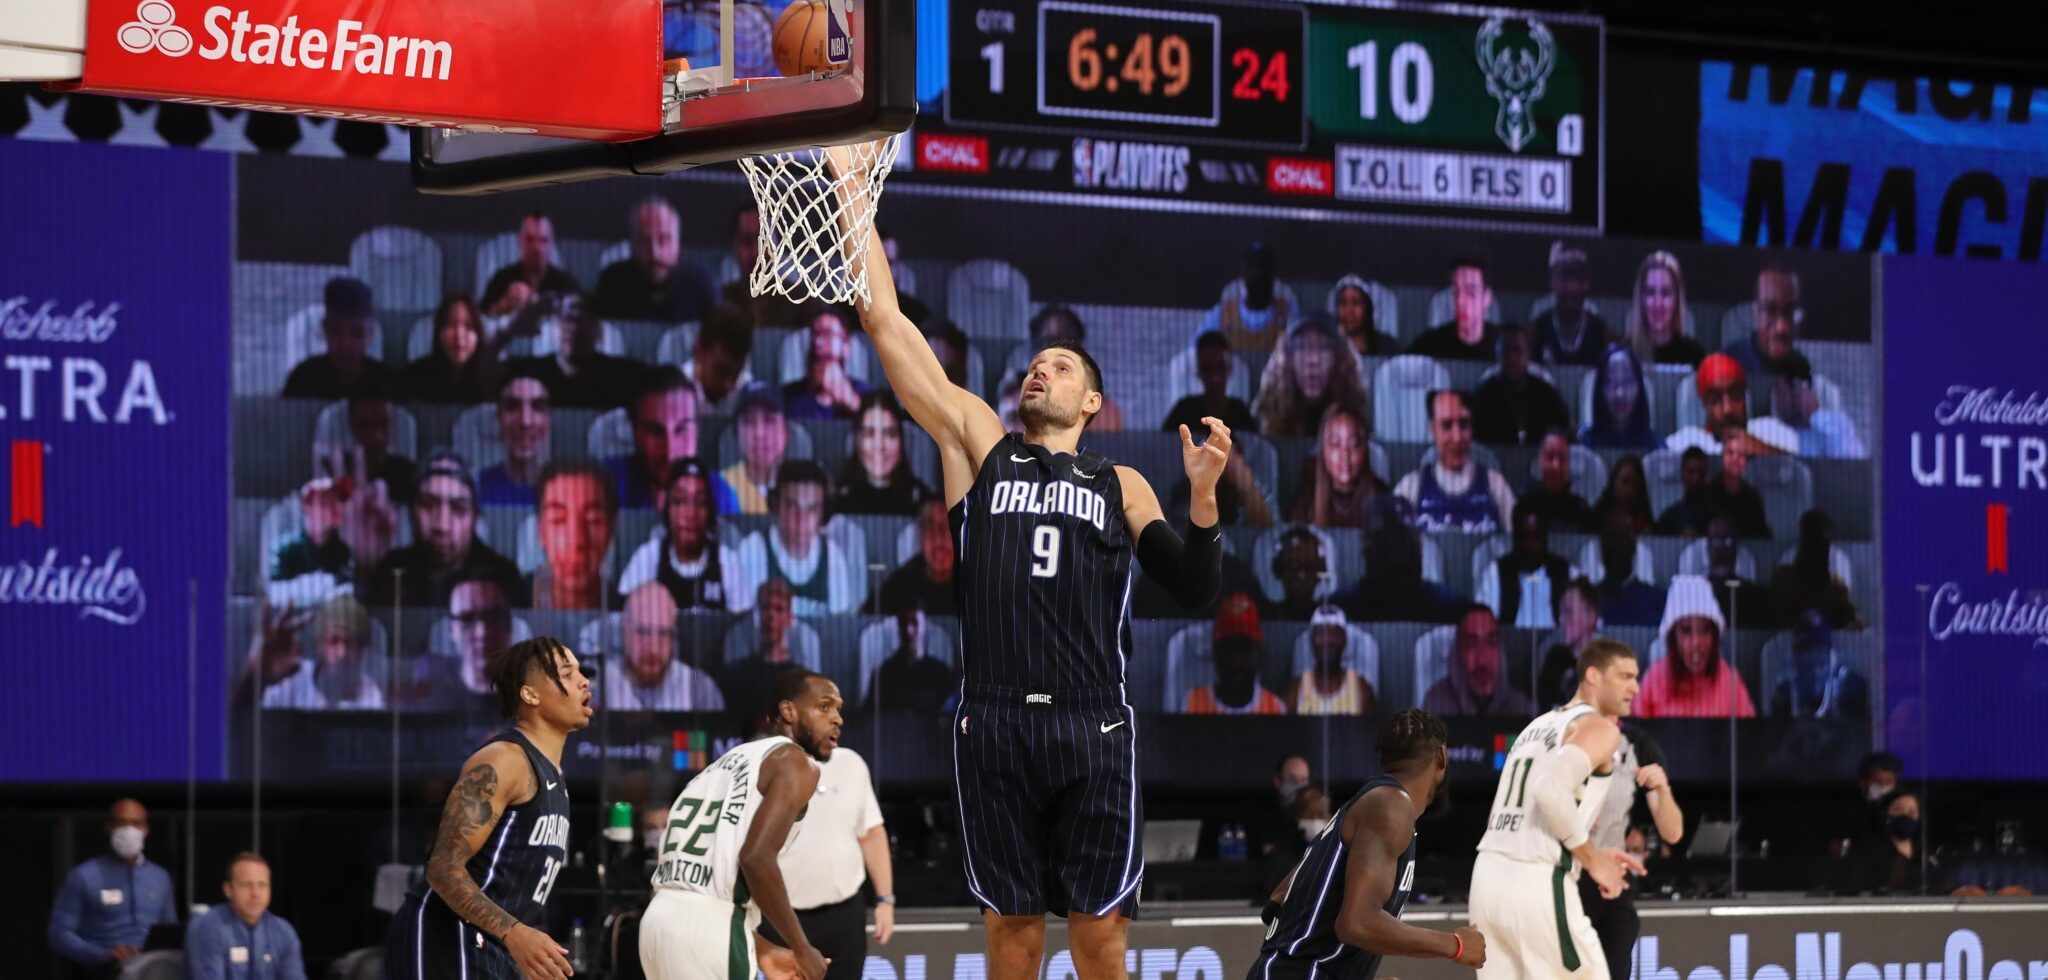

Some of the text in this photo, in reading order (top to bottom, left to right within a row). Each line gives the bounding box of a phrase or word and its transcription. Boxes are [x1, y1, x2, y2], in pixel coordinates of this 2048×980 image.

[830, 37, 846, 56] NBA
[981, 42, 1004, 94] 1
[1068, 29, 1191, 96] 6:49
[1232, 48, 1290, 101] 24
[1347, 40, 1434, 124] 10
[1092, 141, 1190, 191] PLAYOFFS
[1434, 164, 1449, 193] 6
[1471, 167, 1556, 199] FLS 0
[1738, 158, 2048, 262] MAGI
[0, 354, 168, 425] TRA
[1910, 431, 2048, 489] ULTR
[990, 480, 1106, 531] ORLANDO
[1031, 525, 1060, 578] 9
[1929, 581, 2048, 649] Courtsi
[1026, 693, 1052, 704] MAGIC
[1503, 758, 1534, 808] 11
[663, 797, 724, 857] 22
